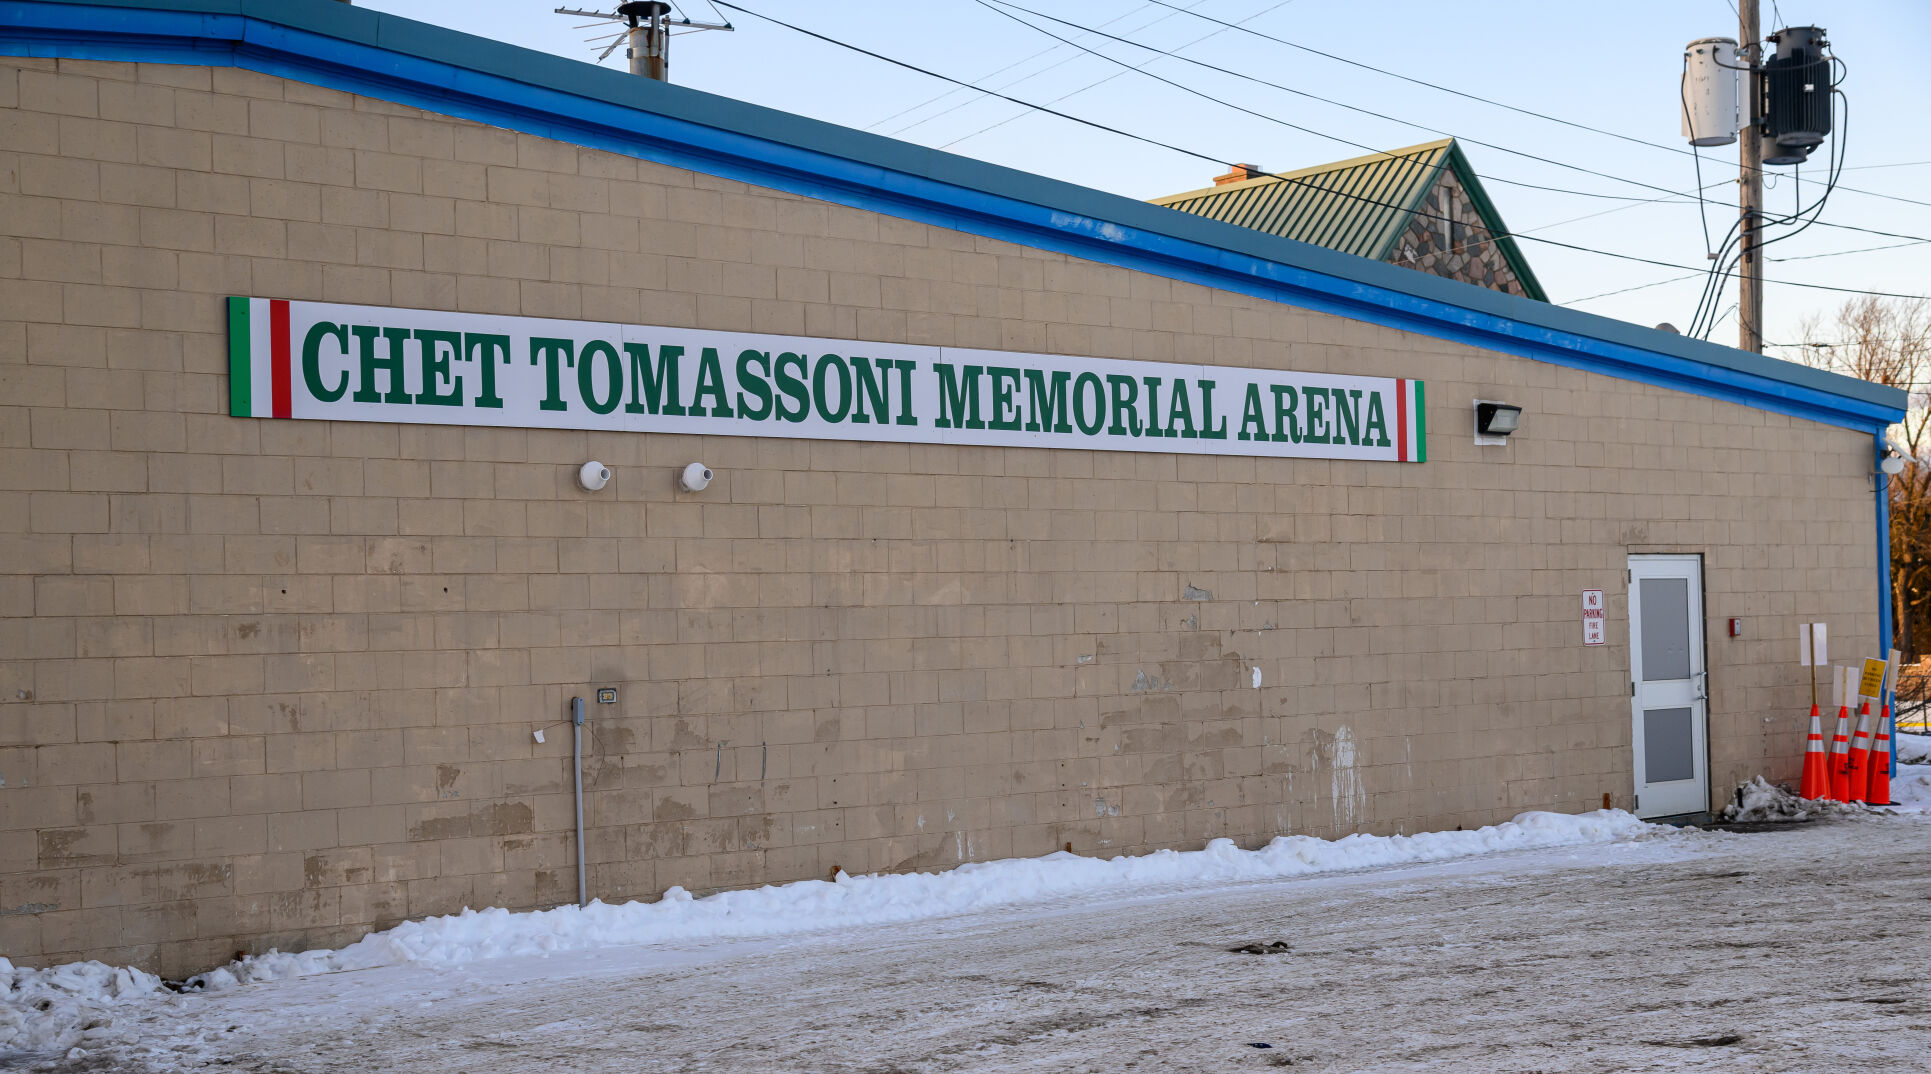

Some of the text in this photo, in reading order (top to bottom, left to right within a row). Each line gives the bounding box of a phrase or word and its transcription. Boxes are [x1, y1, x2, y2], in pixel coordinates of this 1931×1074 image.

[301, 321, 1392, 448] CHET TOMASSONI MEMORIAL ARENA
[1588, 595, 1597, 605] NO
[1583, 608, 1603, 618] PARKING
[1588, 621, 1598, 629] FIRE
